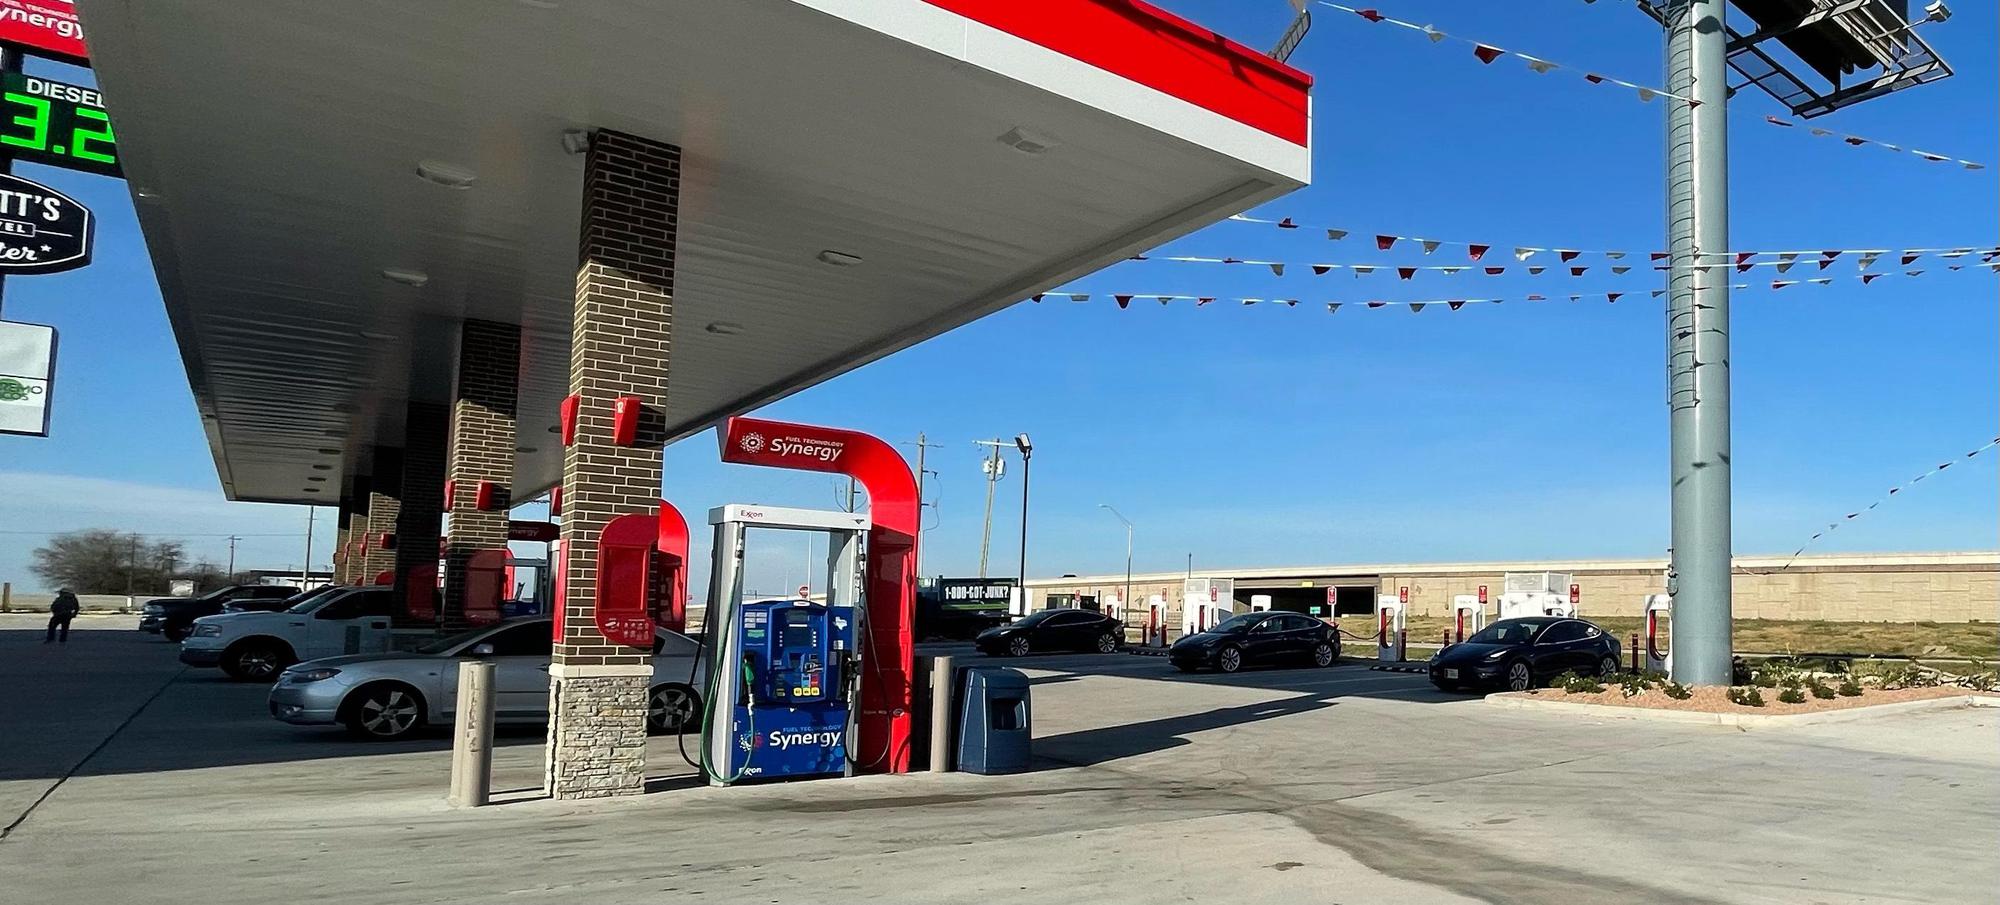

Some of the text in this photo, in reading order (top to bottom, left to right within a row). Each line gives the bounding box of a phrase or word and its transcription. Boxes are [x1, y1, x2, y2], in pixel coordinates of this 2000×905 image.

[27, 78, 105, 108] DIESEL
[770, 438, 842, 462] Synergy
[741, 510, 763, 519] Exxon
[945, 586, 1009, 600] 1-800-GOT-JUNK?
[769, 730, 841, 751] Synergy
